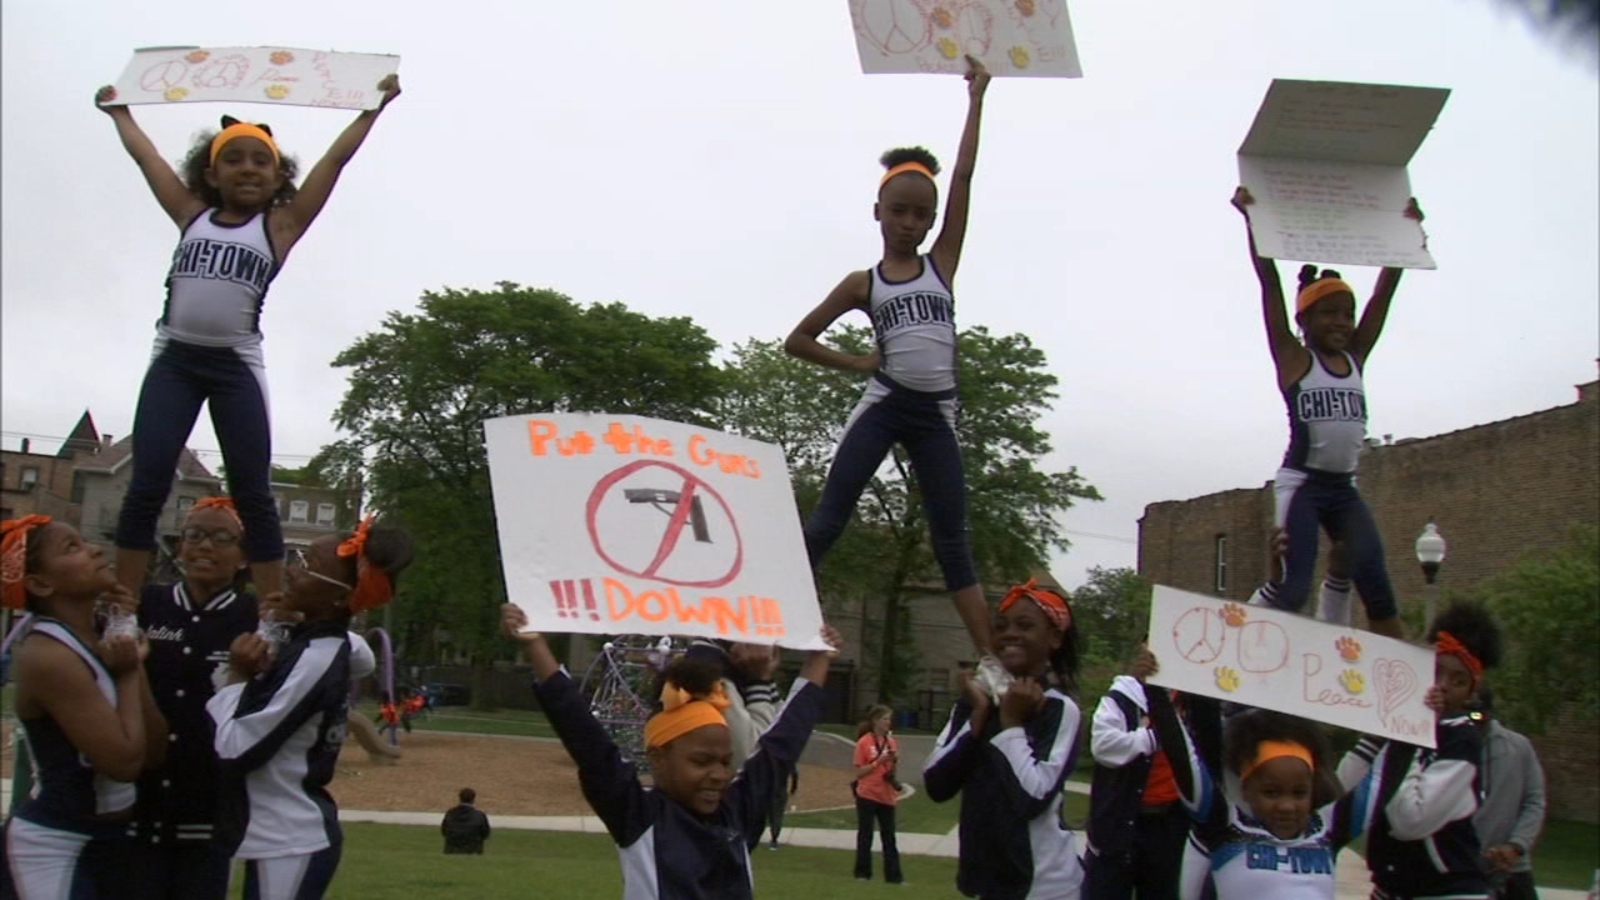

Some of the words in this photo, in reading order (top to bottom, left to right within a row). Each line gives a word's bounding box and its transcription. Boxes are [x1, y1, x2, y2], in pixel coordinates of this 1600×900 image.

[527, 419, 595, 456] Put
[603, 421, 674, 457] the
[687, 433, 761, 479] Guns
[1302, 653, 1374, 708] Peace
